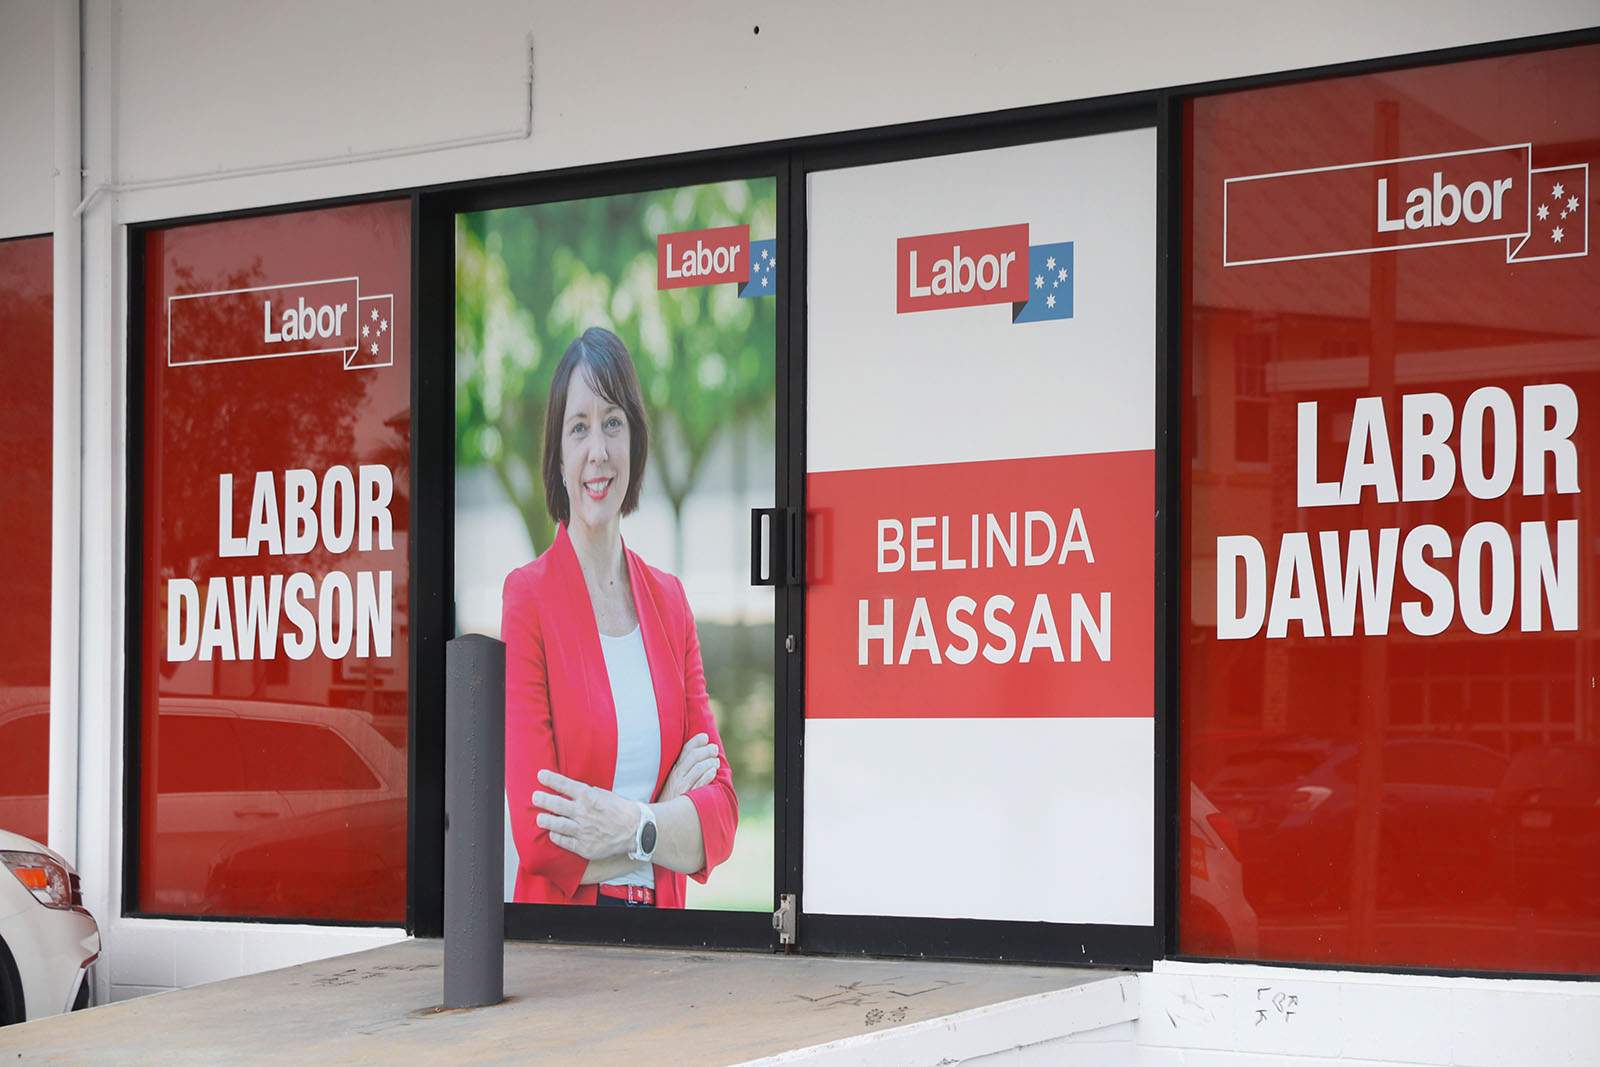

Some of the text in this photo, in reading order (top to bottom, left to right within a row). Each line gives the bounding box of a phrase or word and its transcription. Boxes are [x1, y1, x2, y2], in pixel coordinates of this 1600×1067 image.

[1377, 171, 1513, 233] Labor
[666, 240, 741, 279] Labor
[909, 245, 1016, 298] Labor
[264, 296, 348, 343] Labor
[1297, 383, 1581, 508] LABOR
[218, 464, 395, 558] LABOR
[877, 507, 1095, 573] BELINDA
[1216, 519, 1579, 640] DAWSON
[166, 569, 393, 662] DAWSON
[858, 591, 1112, 667] HASSAN
